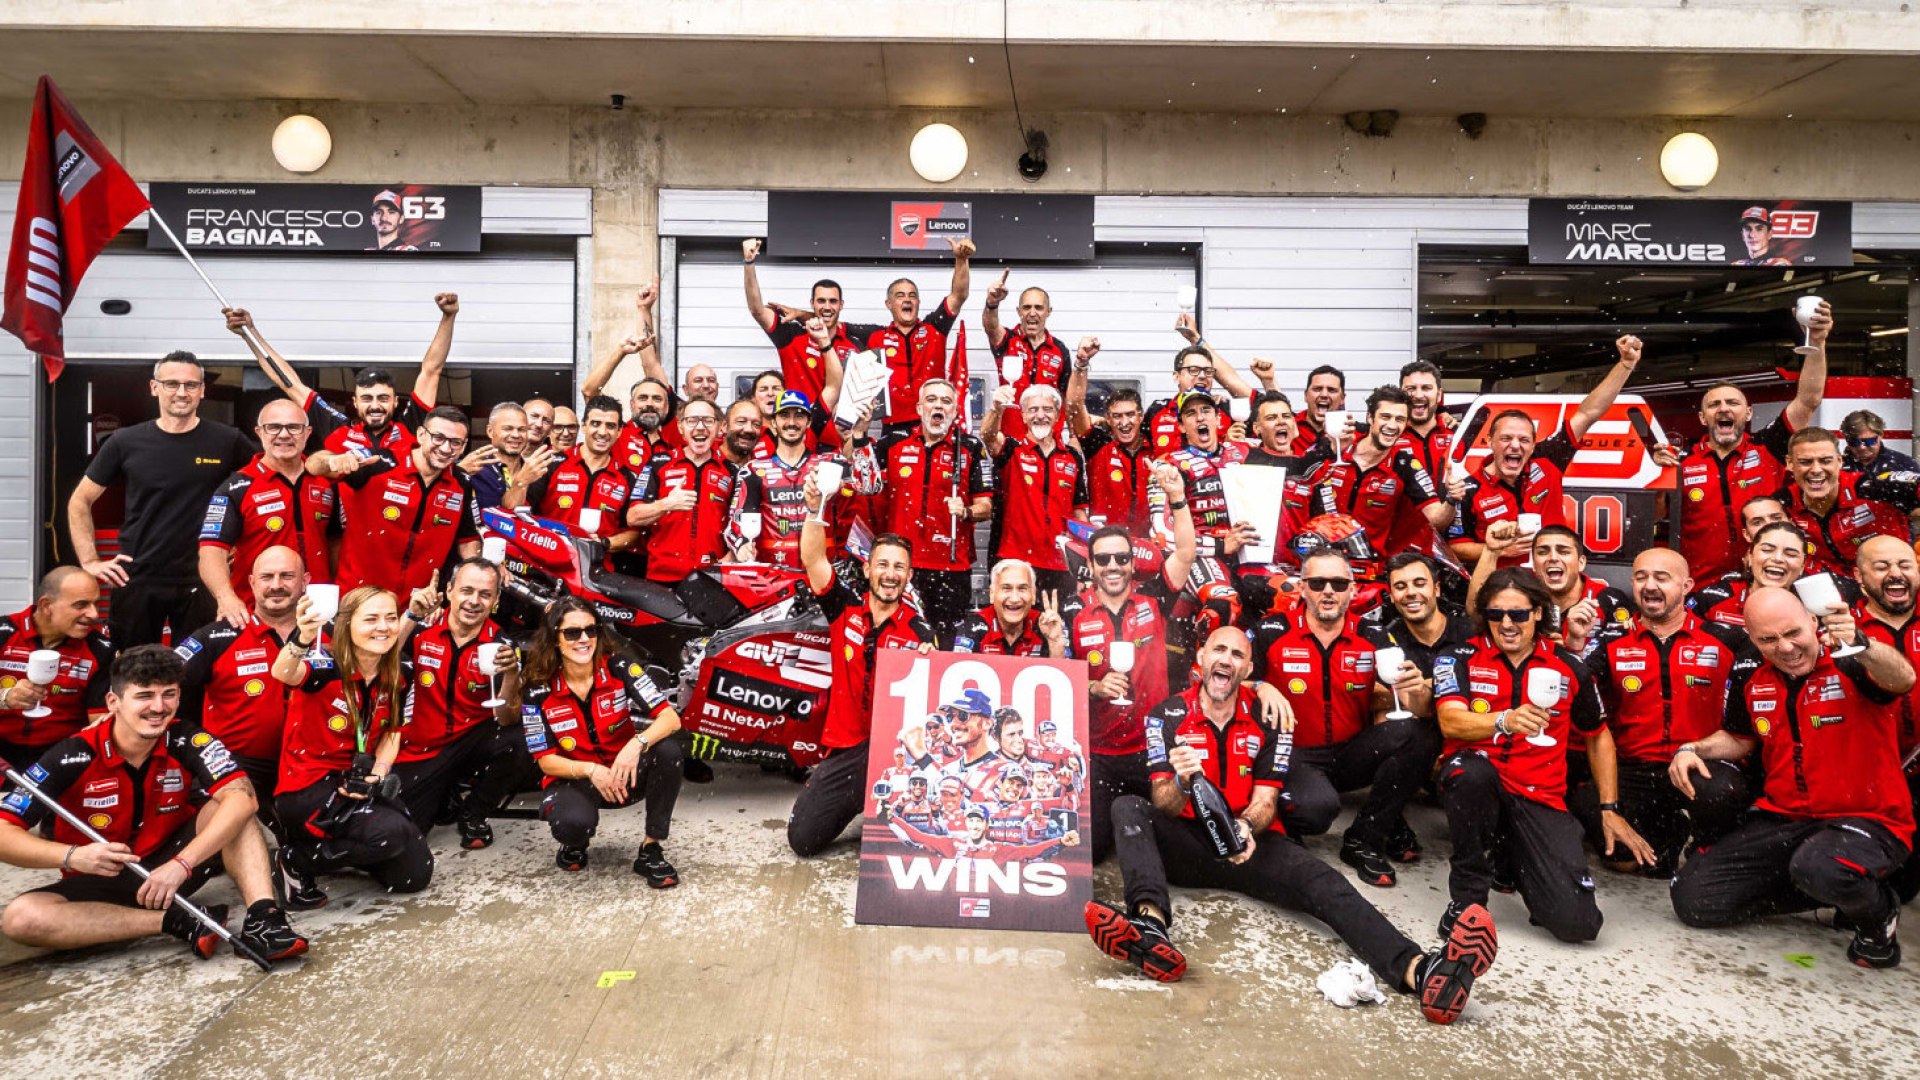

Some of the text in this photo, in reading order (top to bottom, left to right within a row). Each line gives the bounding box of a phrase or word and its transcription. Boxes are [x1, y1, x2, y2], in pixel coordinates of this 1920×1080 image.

[402, 197, 445, 219] 63
[187, 208, 364, 228] FRANCESCO
[928, 220, 966, 231] Lenovo
[186, 228, 325, 247] BAGNAIA
[1565, 223, 1652, 241] MARC
[1565, 243, 1726, 261] MARQUEZ
[1196, 480, 1222, 493] Len
[499, 521, 514, 533] TIM
[528, 533, 558, 551] riello
[1132, 547, 1153, 561] ello
[793, 632, 832, 645] DUCAT
[735, 641, 785, 665] GIVI
[715, 676, 813, 715] Lenovo
[889, 657, 1074, 746] 100
[1206, 820, 1228, 856] Castaldi
[887, 855, 1067, 897] WINS
